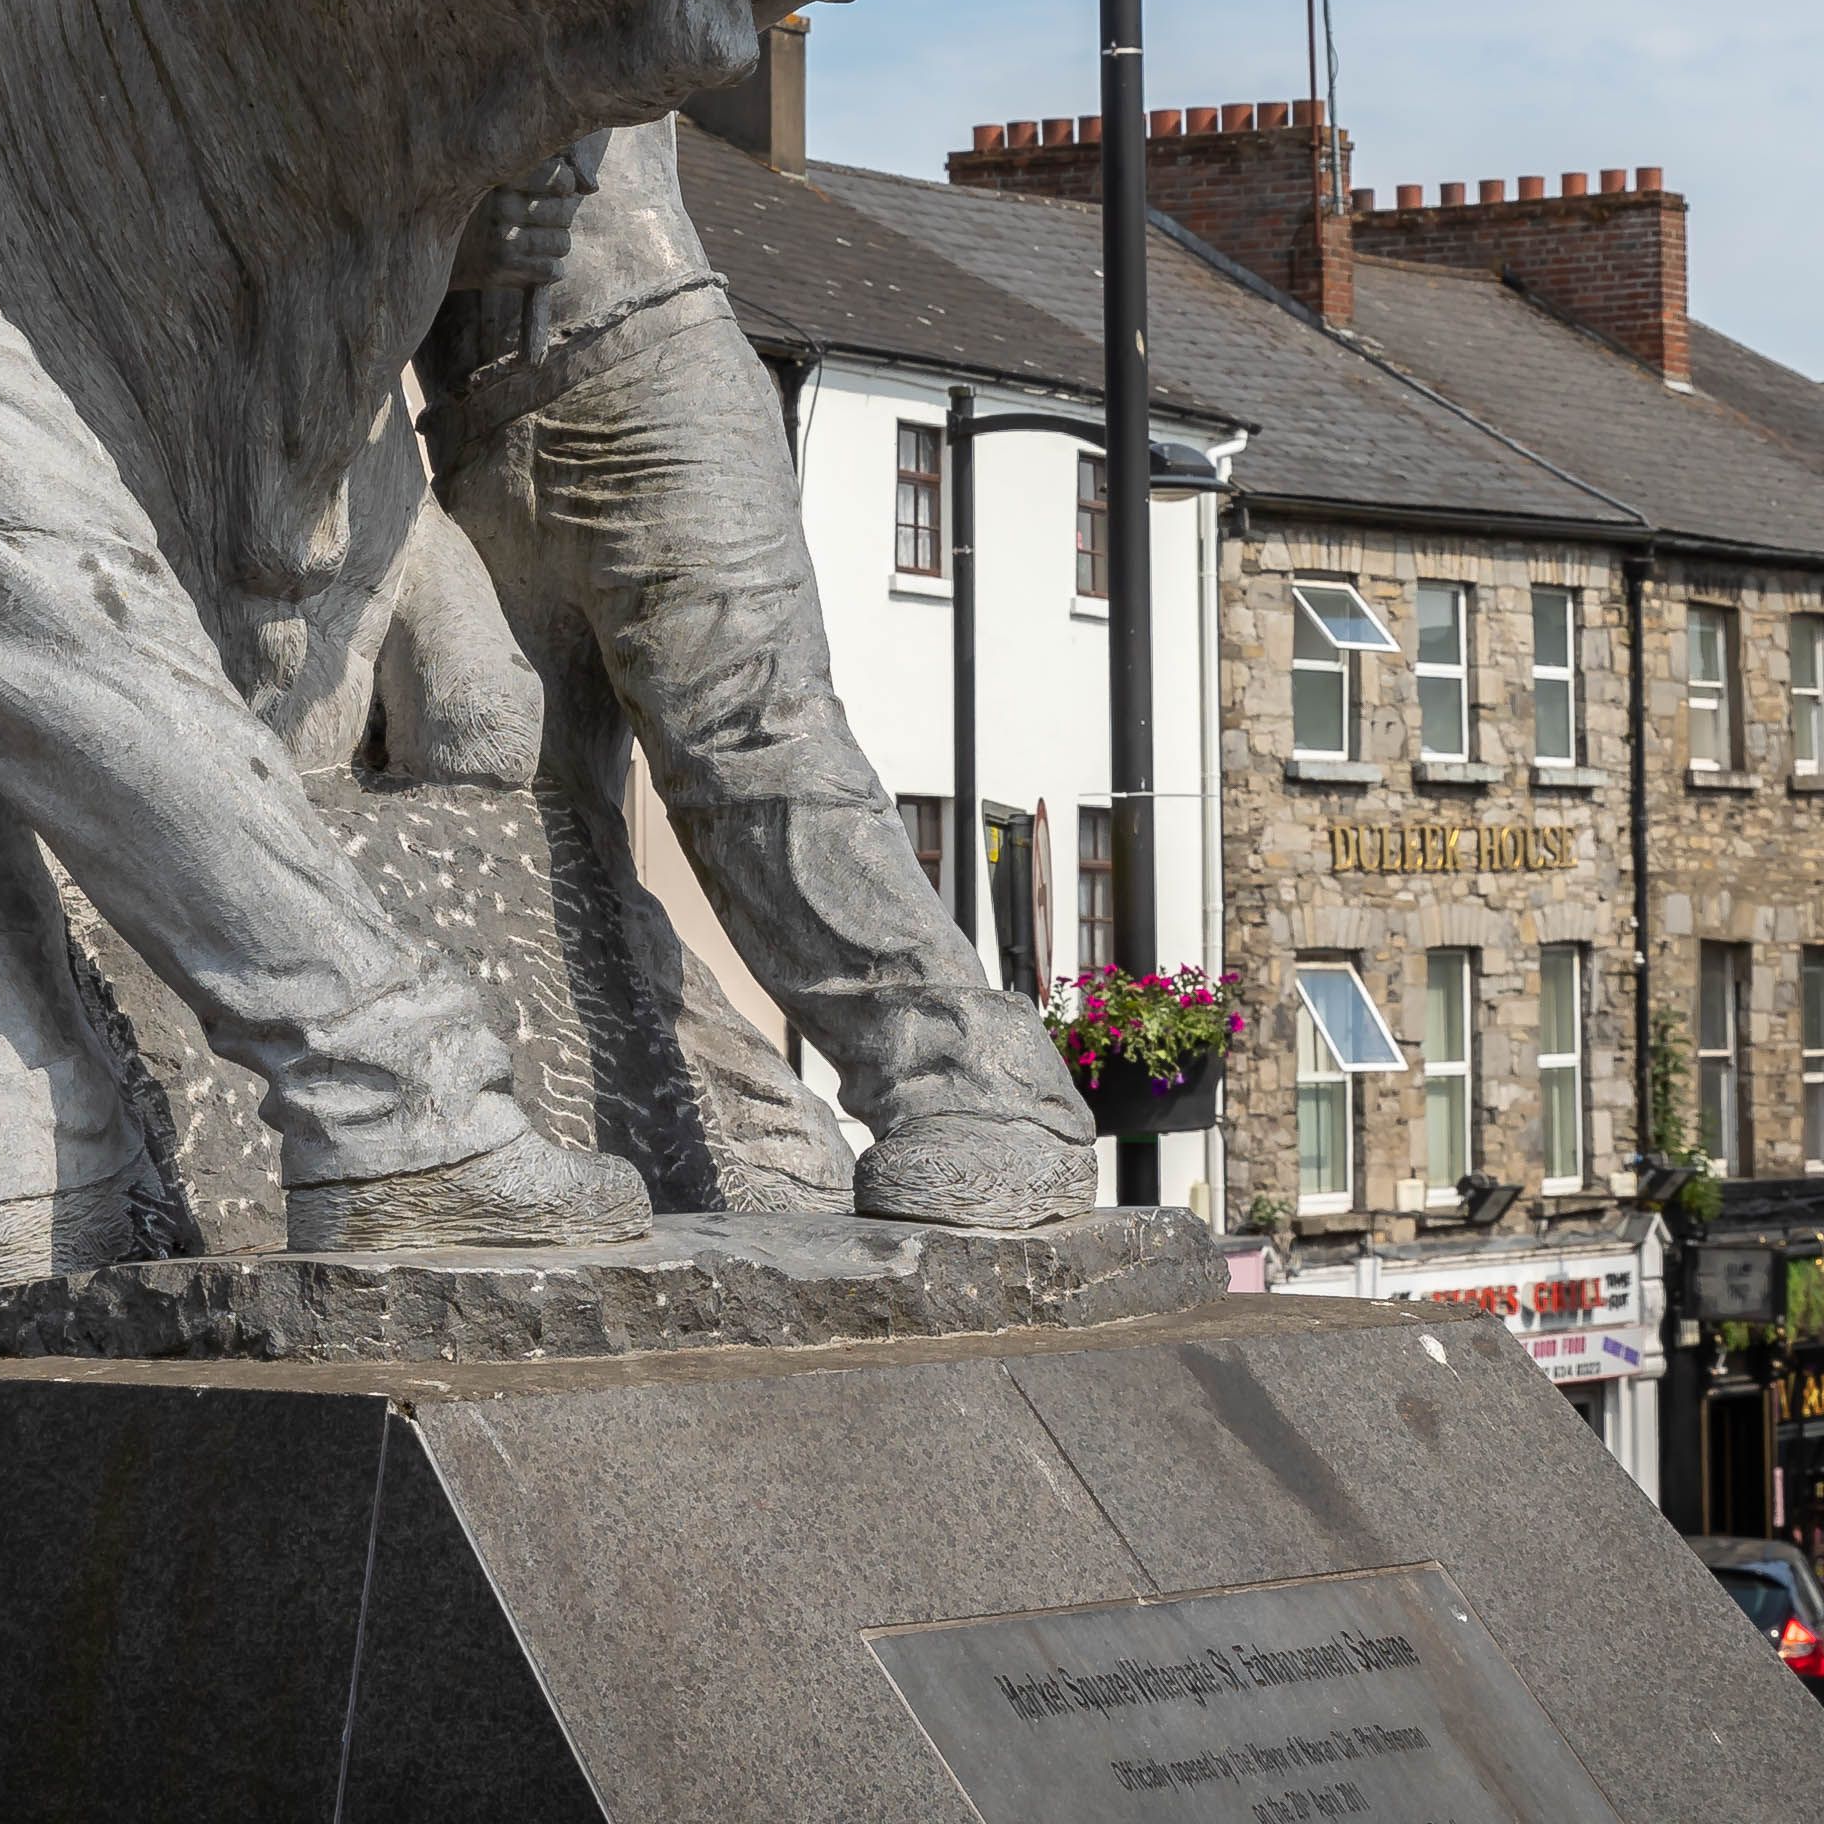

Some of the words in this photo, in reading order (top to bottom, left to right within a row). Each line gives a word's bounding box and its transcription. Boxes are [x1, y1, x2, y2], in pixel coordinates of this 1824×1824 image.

[1332, 826, 1460, 872] DULEEK
[1477, 826, 1578, 871] HOUSE
[994, 1672, 1075, 1720] Market
[1231, 1635, 1359, 1688] Enhancement
[1339, 1627, 1421, 1672] Scheme
[1307, 1785, 1346, 1822] April
[1335, 1781, 1370, 1812] 2011
